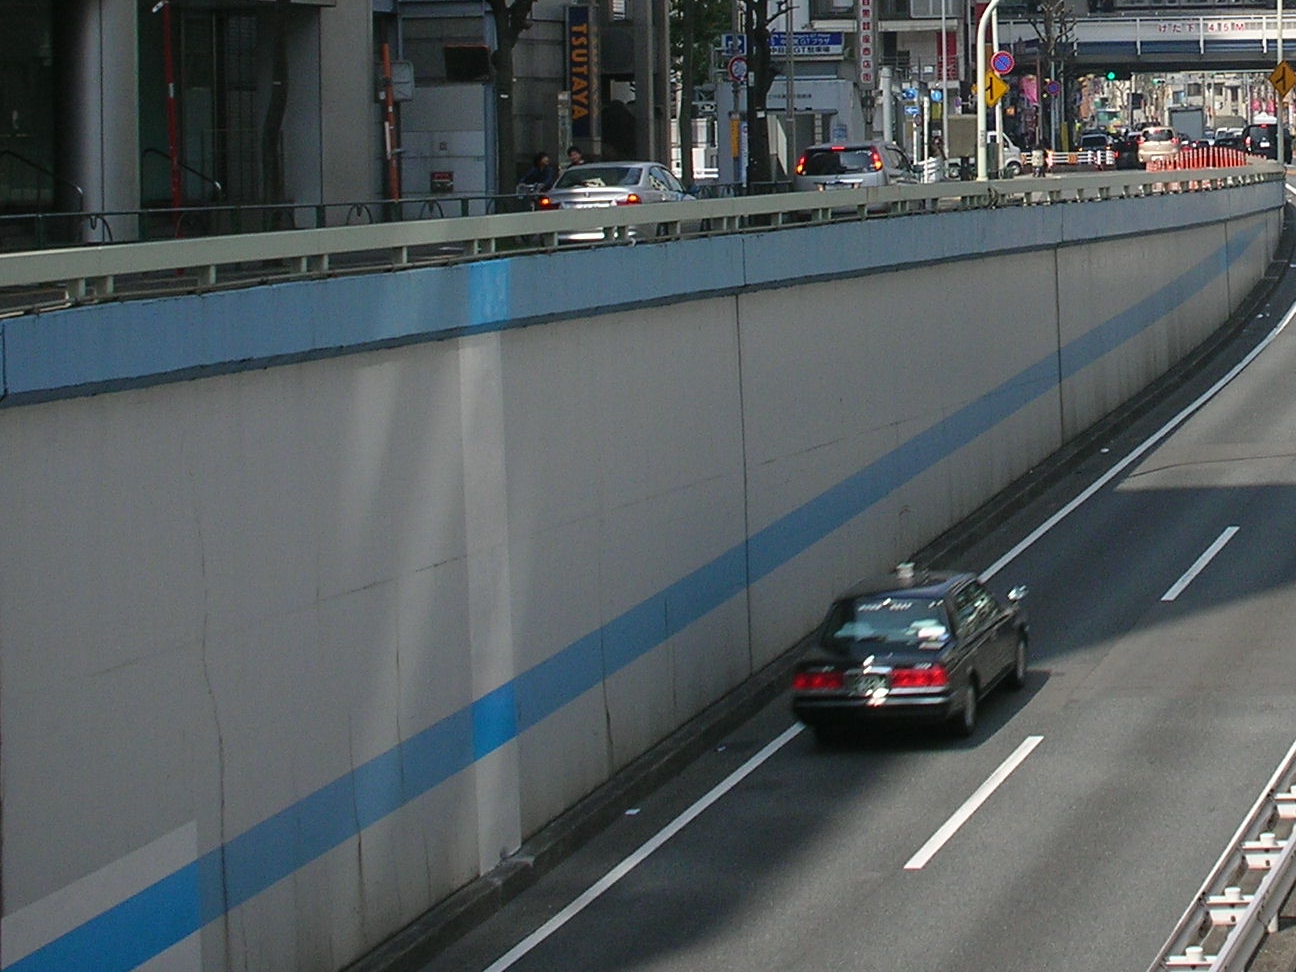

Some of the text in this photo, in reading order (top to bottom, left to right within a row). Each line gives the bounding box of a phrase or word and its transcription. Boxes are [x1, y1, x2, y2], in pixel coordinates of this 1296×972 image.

[1158, 23, 1195, 33] けた下
[571, 23, 589, 120] TSUTAYA
